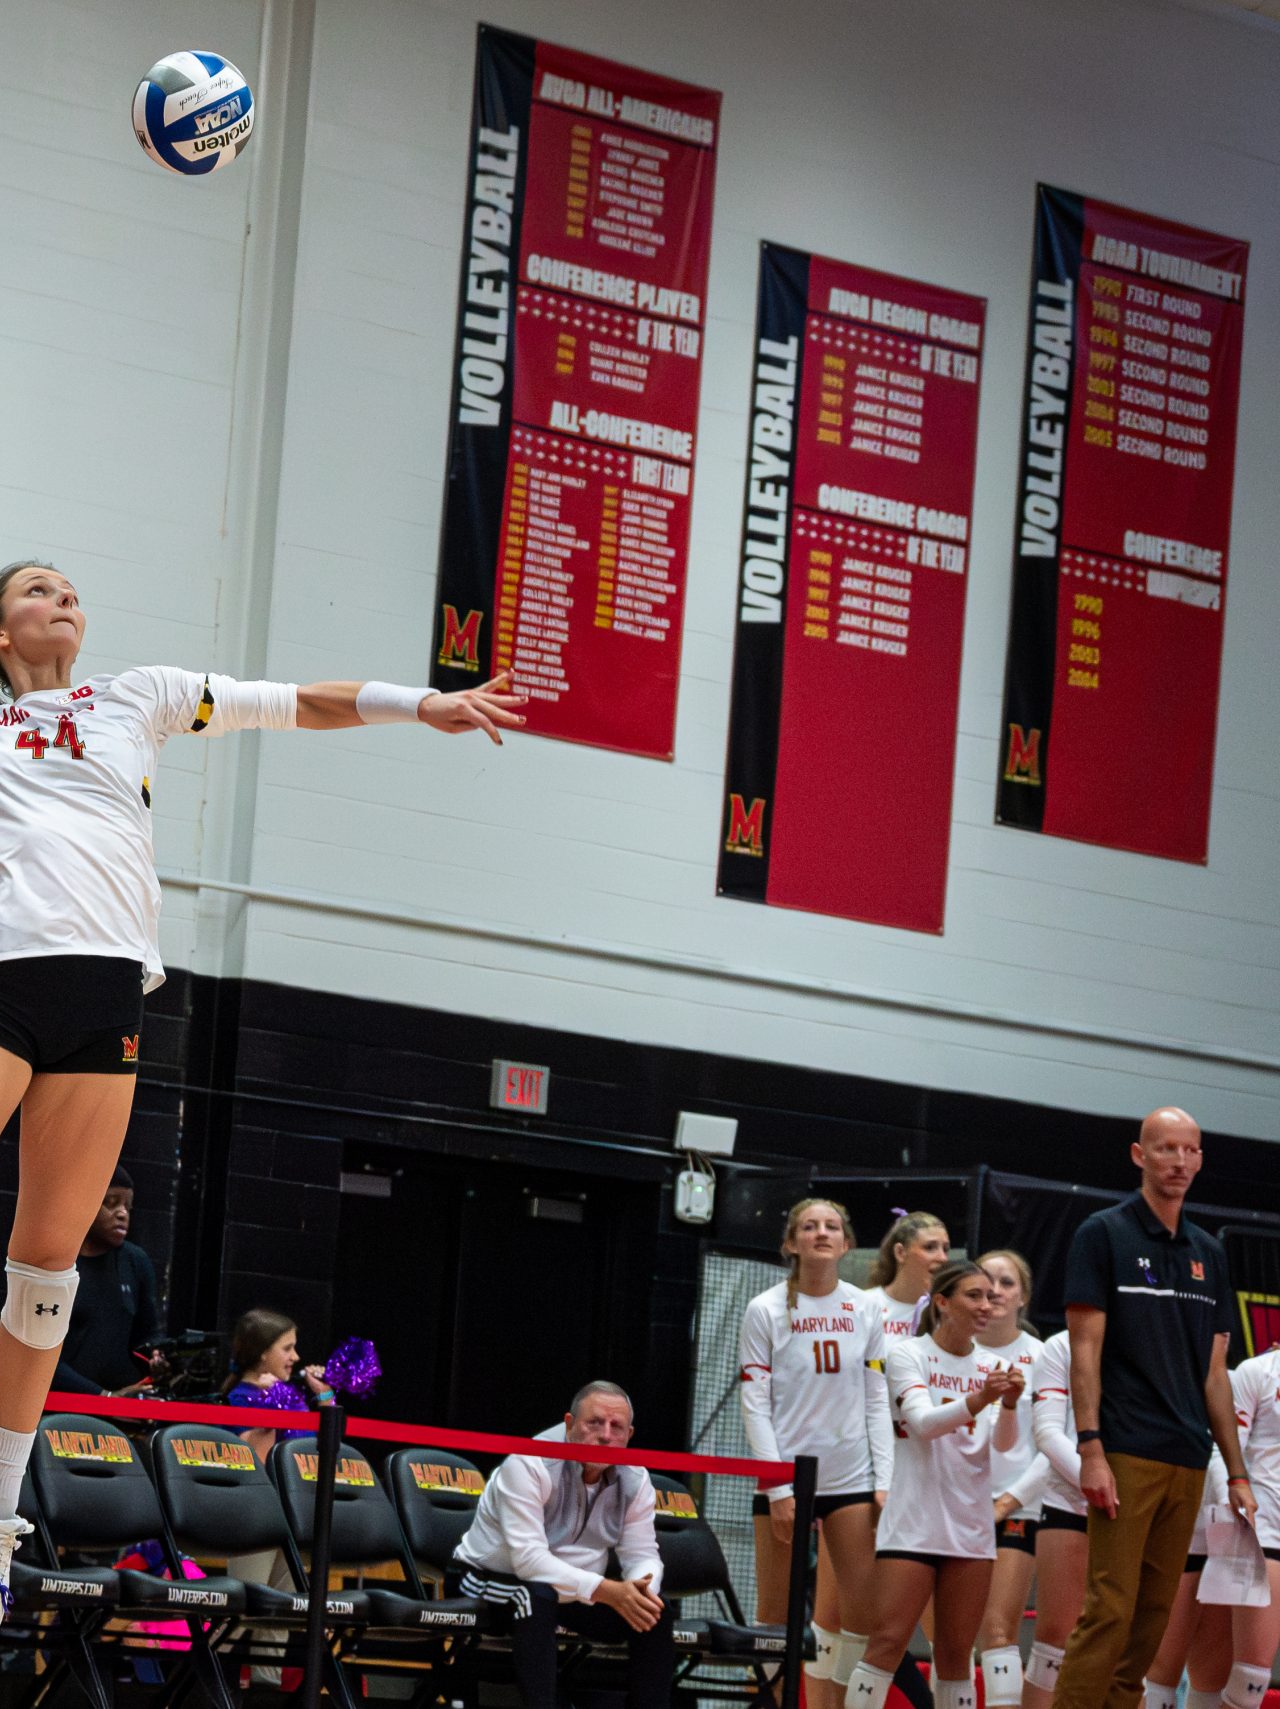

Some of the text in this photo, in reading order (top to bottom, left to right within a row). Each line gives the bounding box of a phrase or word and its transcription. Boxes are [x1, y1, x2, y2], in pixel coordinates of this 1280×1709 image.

[193, 115, 251, 152] molten
[194, 95, 243, 134] NCAA
[459, 125, 520, 427] VOLLEYBALL
[527, 254, 700, 323] CONFERENCE PLAYER
[1126, 284, 1160, 308] FIRST
[1162, 293, 1202, 320] ROUND
[1124, 309, 1169, 337] SECOND
[1172, 320, 1212, 348] ROUND
[1123, 334, 1168, 361] SECOND
[1170, 346, 1210, 373] ROUND
[1121, 359, 1167, 386] SECOND
[1169, 371, 1210, 398] ROUND
[1020, 277, 1073, 558] VOLLEYBALL
[1120, 383, 1165, 411] SECOND
[1168, 395, 1209, 422] ROUND
[550, 400, 693, 459] ALL-CONFERENCE
[1118, 408, 1164, 436] SECOND
[1166, 420, 1208, 447] ROUND
[1117, 434, 1162, 461] SECOND
[1164, 445, 1207, 471] ROUND
[741, 335, 798, 623] VOLLEYBALL
[818, 483, 915, 528] CONFERENCE
[15, 719, 86, 759] 44
[728, 794, 766, 849] M
[505, 1066, 544, 1108] EXIT
[791, 1317, 854, 1334] MARYLAND
[813, 1340, 840, 1374] 10
[929, 1372, 986, 1393] MARYLAN
[45, 1430, 132, 1457] MARYLAND
[171, 1439, 255, 1465] MARYLAND
[41, 1577, 103, 1596] UMTERPS.COM
[168, 1588, 228, 1606] UMTERPS.COM
[420, 1610, 476, 1626] UMTERPS.COM
